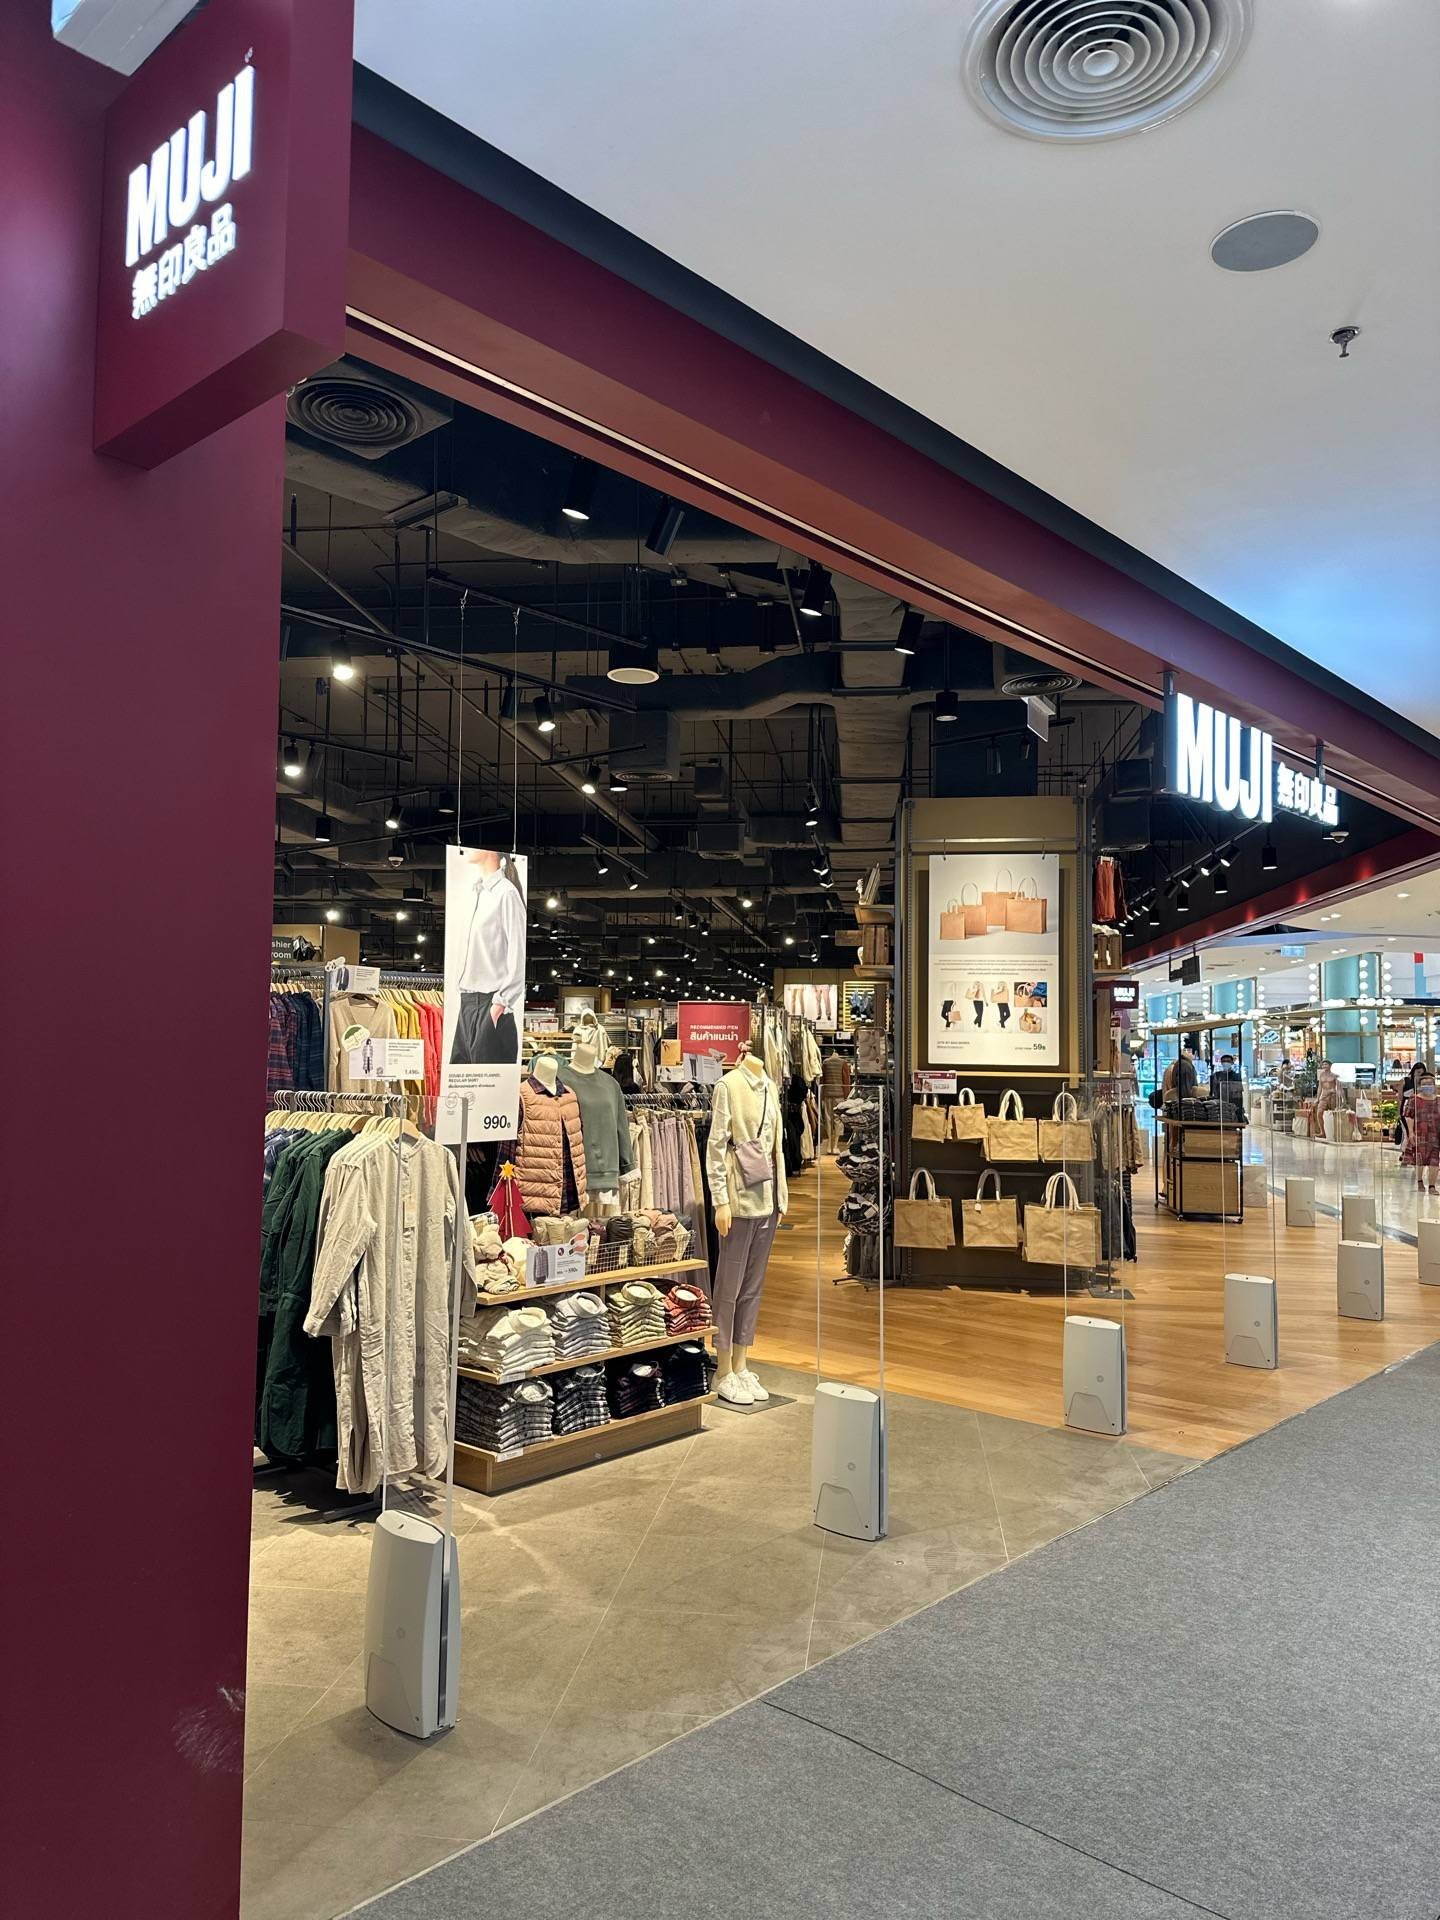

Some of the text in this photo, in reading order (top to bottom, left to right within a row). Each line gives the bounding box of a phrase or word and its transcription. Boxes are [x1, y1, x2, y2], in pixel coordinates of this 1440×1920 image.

[125, 65, 255, 267] MUJI
[131, 202, 236, 319] 無印良品
[1177, 692, 1272, 823] MUJI
[690, 1030, 739, 1041] สินค้าแนะนำ
